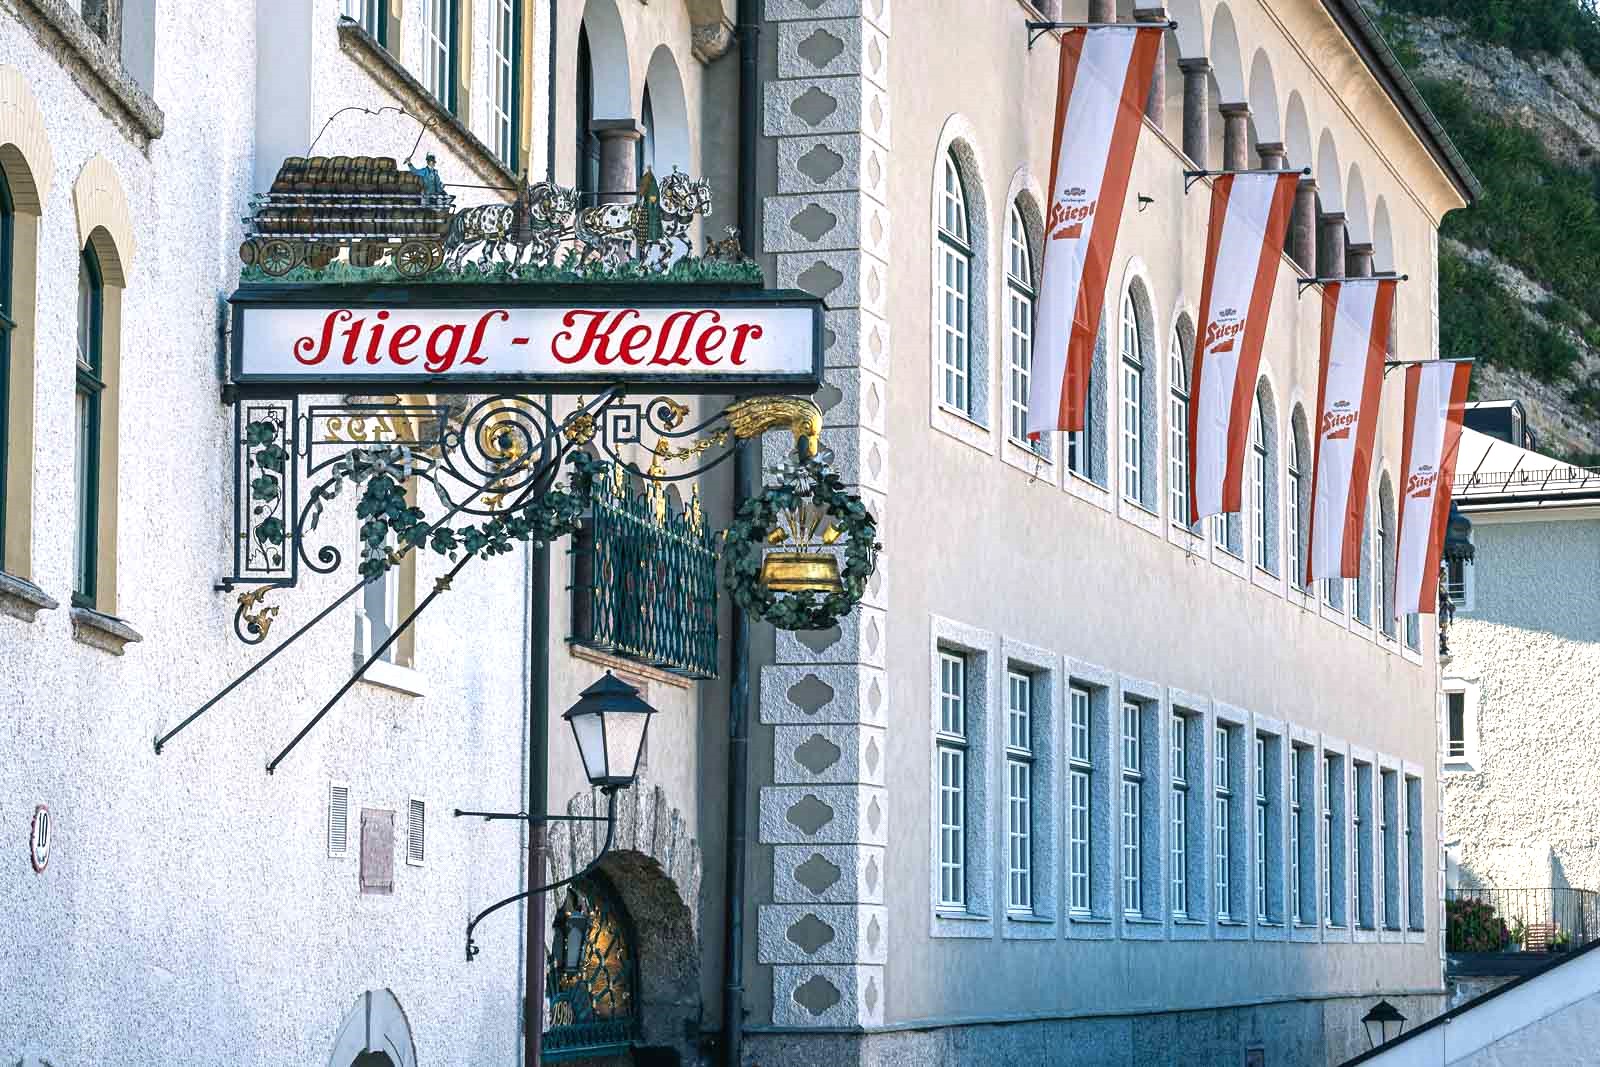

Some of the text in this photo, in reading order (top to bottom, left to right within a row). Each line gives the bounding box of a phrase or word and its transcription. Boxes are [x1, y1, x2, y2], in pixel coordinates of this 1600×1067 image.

[1050, 201, 1096, 232] Stiegl
[294, 309, 508, 373] Stiegl
[552, 309, 763, 367] Keller
[1206, 320, 1245, 347] Stiegl
[1322, 411, 1358, 433] Stiegl
